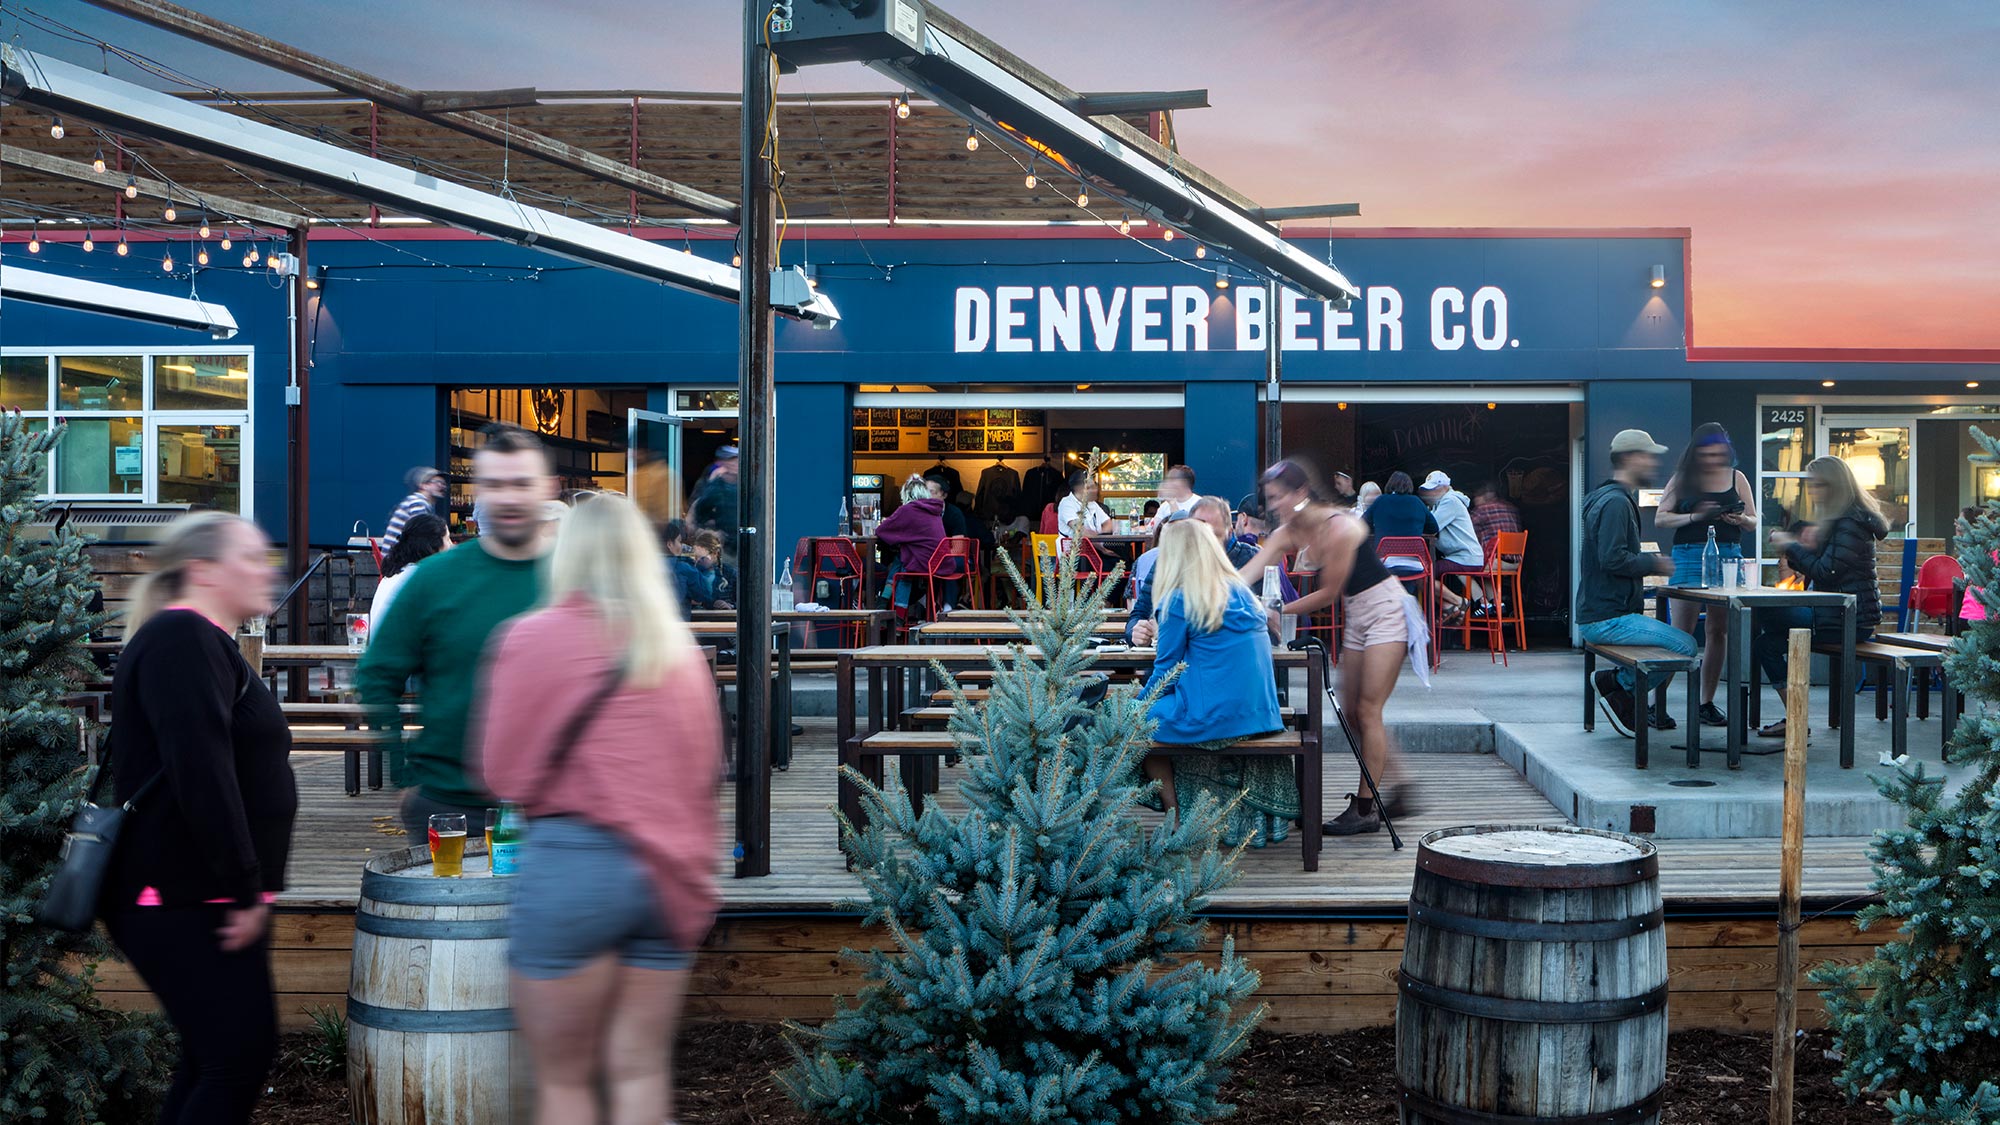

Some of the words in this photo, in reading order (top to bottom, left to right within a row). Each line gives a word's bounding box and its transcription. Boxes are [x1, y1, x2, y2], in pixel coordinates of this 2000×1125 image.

[954, 286, 1210, 352] DENVER
[1235, 286, 1403, 351] BEER
[1430, 286, 1520, 351] CO.
[1771, 410, 1805, 423] 2425
[852, 476, 870, 488] -GO
